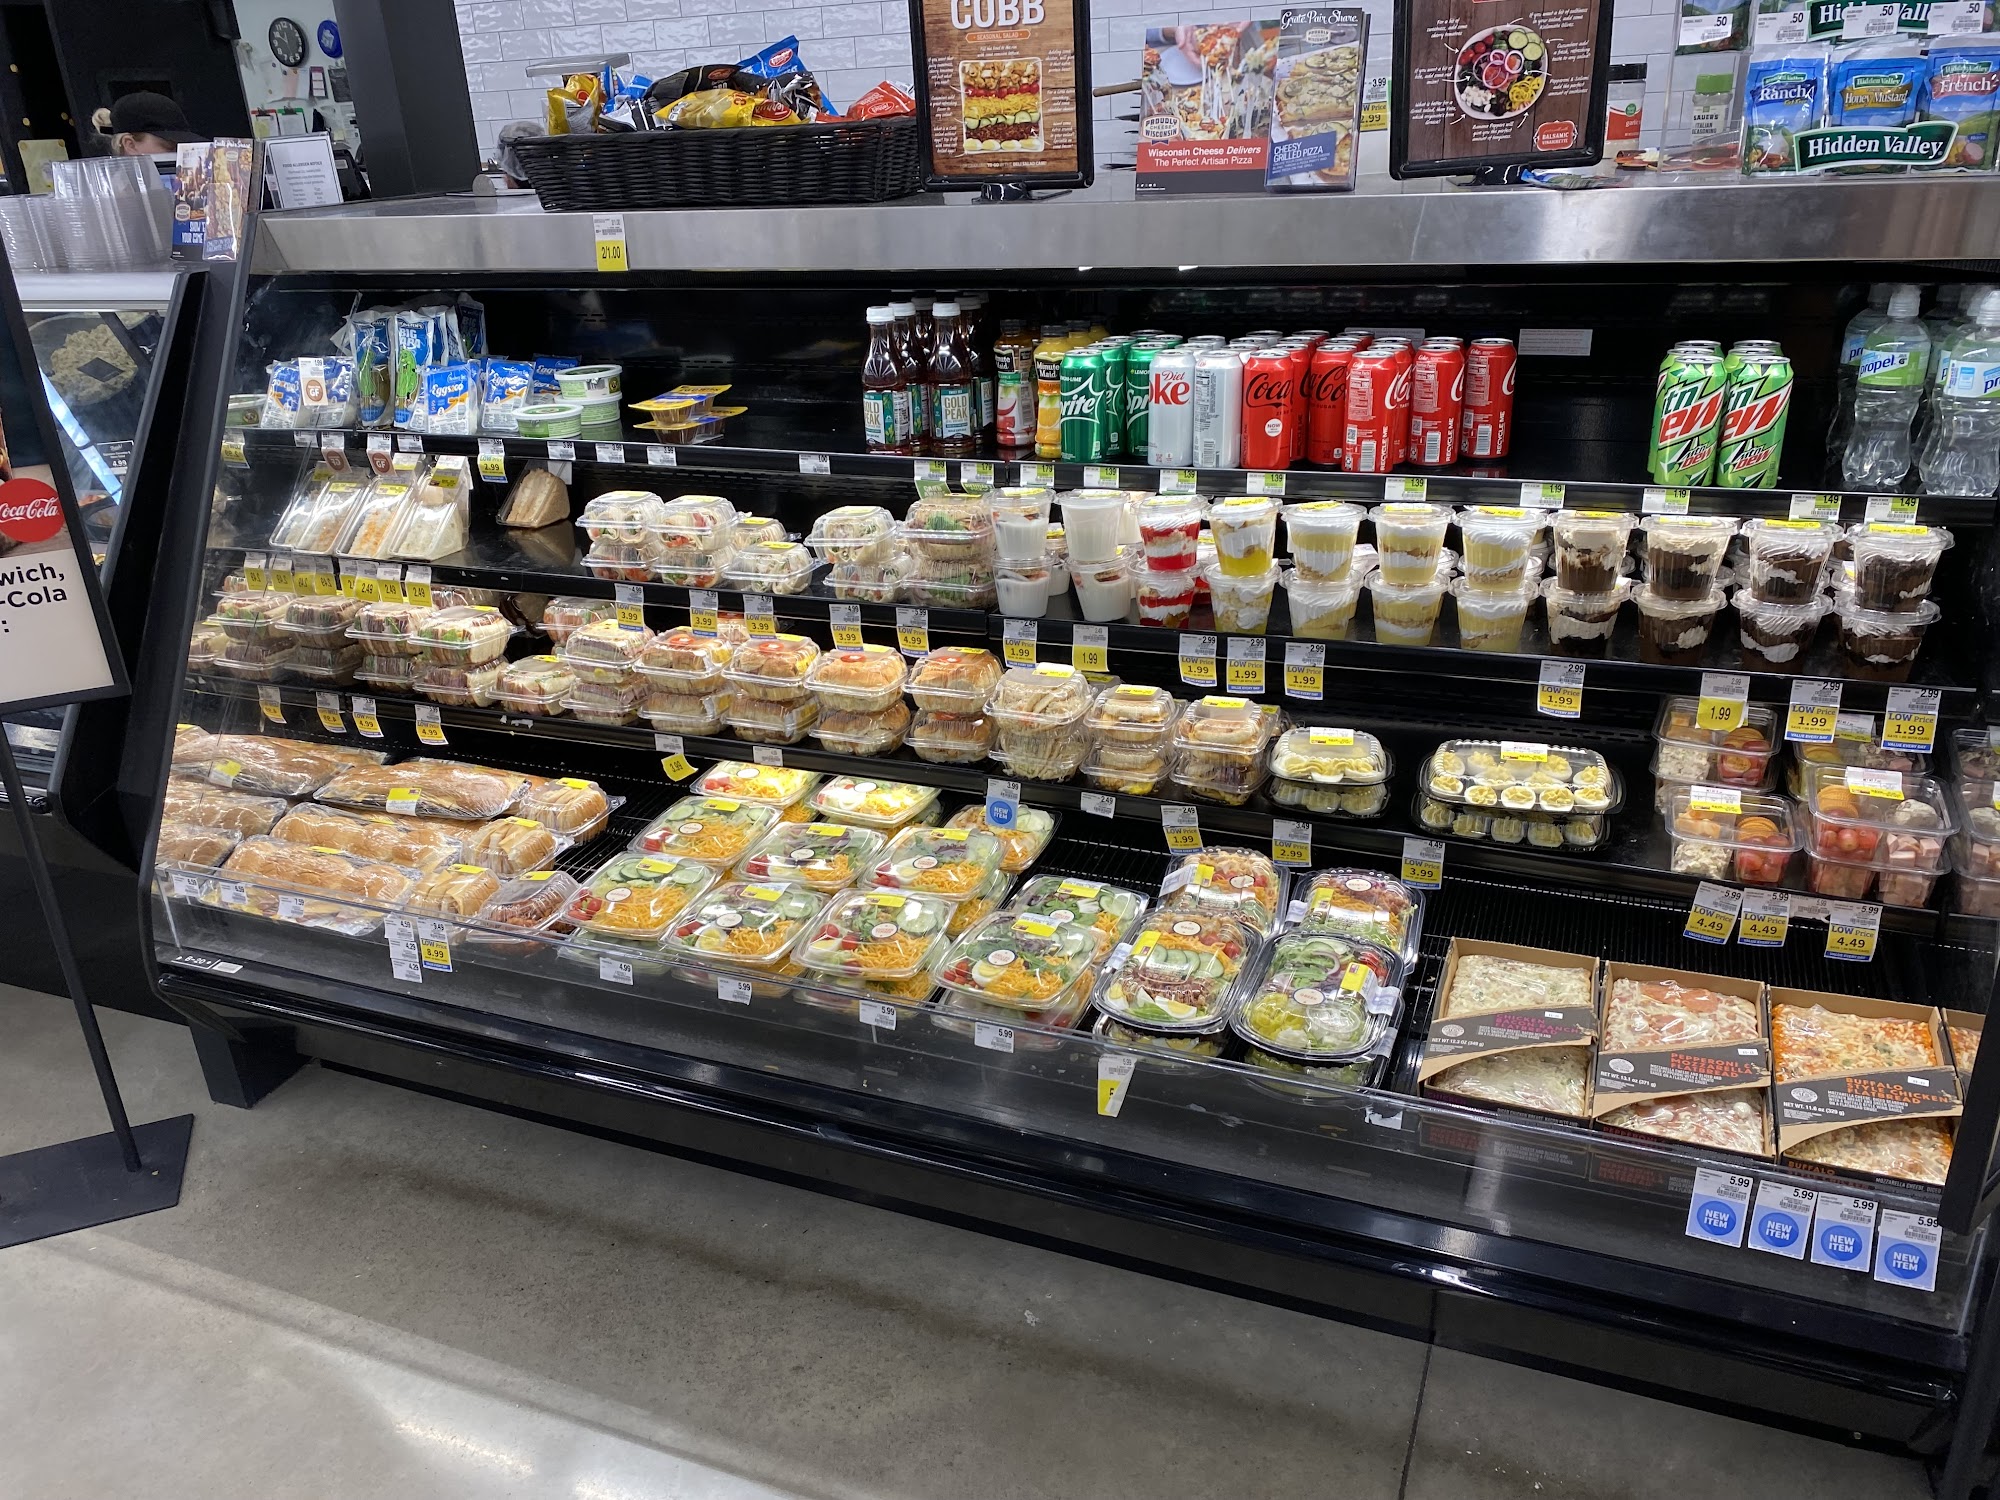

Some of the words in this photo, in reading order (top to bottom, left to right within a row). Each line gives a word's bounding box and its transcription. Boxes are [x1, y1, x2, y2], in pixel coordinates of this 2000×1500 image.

[950, 0, 1045, 30] COBB
[1789, 12, 1804, 24] .50
[1713, 16, 1728, 27] .50
[976, 32, 1002, 41] SEASONAL
[1002, 31, 1019, 39] SALAD
[1372, 77, 1387, 87] 3.99
[1856, 77, 1880, 85] Hidden
[1880, 77, 1901, 86] Valley
[1939, 77, 1991, 94] French
[1759, 85, 1806, 102] Ranch
[1845, 92, 1871, 106] Honey
[1872, 90, 1909, 103] Mustard
[1693, 113, 1719, 121] SAUER'S
[1145, 118, 1178, 127] PROUDLY
[1145, 128, 1178, 138] WISCONSIN
[1541, 131, 1570, 140] BALSAMIC
[1148, 148, 1191, 157] Wisconsin
[1193, 147, 1224, 156] Cheese
[1226, 146, 1261, 155] Delivers
[1274, 142, 1302, 155] CHEESY
[1807, 134, 1880, 158] Hidden
[1883, 134, 1944, 159] Valley
[1273, 150, 1302, 163] GRILLED
[1302, 145, 1324, 157] PIZZA
[1154, 158, 1170, 167] The
[1171, 157, 1199, 166] Perfect
[1201, 156, 1229, 165] Artisan
[1231, 156, 1253, 164] Pizza
[601, 246, 621, 259] 2/1.00
[399, 328, 417, 339] BIG
[1036, 361, 1060, 371] Minute
[1860, 355, 1895, 376] propel
[1039, 369, 1058, 379] Maid
[1161, 370, 1186, 381] Diet
[309, 387, 320, 397] GF
[944, 395, 967, 408] GOLD
[945, 408, 968, 420] PEAK
[1500, 410, 1505, 422] ME
[1449, 417, 1454, 429] ME
[1382, 426, 1389, 438] ME
[1497, 422, 1505, 455] RECYCLE
[1446, 429, 1454, 462] RECYCLE
[1380, 439, 1388, 471] RECYCLE
[112, 459, 127, 467] 4.99
[376, 460, 386, 469] GF
[483, 463, 500, 471] 2.99
[981, 461, 993, 471] 1.79
[1042, 463, 1053, 473] 1.79
[1105, 468, 1117, 476] 1.39
[1184, 470, 1195, 478] 1.39
[1271, 473, 1283, 483] 1.39
[1411, 478, 1424, 487] 1.39
[1549, 484, 1562, 493] 1.19
[1673, 489, 1687, 498] 1.19
[1823, 495, 1839, 504] 1.49
[1900, 497, 1916, 507] 1.49
[361, 584, 374, 594] 2.49
[384, 584, 397, 594] 2.49
[413, 587, 426, 597] 2.49
[631, 586, 642, 594] 4.99
[847, 604, 859, 613] 4.99
[621, 611, 638, 621] 3.99
[695, 617, 712, 626] 3.99
[751, 622, 769, 631] 3.99
[838, 633, 857, 642] 3.99
[903, 636, 922, 645] 4.99
[1202, 636, 1216, 644] 2.99
[1250, 639, 1265, 647] 2.99
[1010, 648, 1030, 657] 1.99
[1310, 644, 1324, 653] 2.99
[1082, 652, 1098, 664] 1.99
[1187, 665, 1209, 674] 1.99
[1568, 664, 1584, 673] 2.99
[1234, 670, 1257, 679] 1.99
[1293, 675, 1316, 684] 1.99
[1541, 686, 1561, 694] LOW
[1562, 689, 1580, 697] Price
[1547, 695, 1573, 705] 1.99
[1710, 707, 1731, 721] 1.99
[1791, 704, 1816, 714] LOW
[1816, 708, 1836, 716] Price
[1798, 716, 1827, 727] 1.99
[1888, 713, 1913, 722] LOW
[1913, 715, 1934, 724] Price
[359, 720, 374, 728] 4.99
[422, 728, 438, 736] 4.99
[1894, 724, 1925, 735] 1.99
[669, 760, 683, 773] 3.99
[1100, 796, 1114, 805] 2.49
[993, 806, 1009, 814] NEW
[993, 812, 1008, 820] ITEM
[1295, 822, 1310, 830] 3.49
[1173, 835, 1194, 844] 1.99
[1428, 841, 1443, 849] 4.49
[1280, 849, 1303, 858] 2.99
[1404, 859, 1423, 867] LOW
[1424, 861, 1441, 869] Price
[1409, 868, 1434, 878] 3.99
[1724, 890, 1742, 900] 5.99
[1771, 892, 1789, 901] 5.99
[1693, 905, 1714, 917] LOW
[1715, 913, 1733, 923] Price
[1744, 913, 1766, 922] LOW
[1767, 917, 1786, 925] Price
[400, 920, 411, 929] 4.59
[1696, 918, 1723, 930] 4.49
[1749, 923, 1778, 934] 4.49
[1831, 925, 1854, 935] LOW
[1855, 930, 1875, 938] Price
[405, 941, 416, 951] 4.29
[1837, 936, 1866, 948] 4.49
[426, 948, 444, 958] 8.99
[408, 962, 419, 971] 4.29
[618, 963, 631, 973] 4.99
[737, 982, 751, 991] 5.99
[881, 1006, 895, 1016] 5.99
[1496, 1014, 1545, 1024] CHICKEN
[1495, 1017, 1534, 1028] BACON
[1539, 1024, 1578, 1034] RANCH
[1495, 1022, 1558, 1035] FLATBREAD
[997, 1028, 1013, 1039] 5.99
[1671, 1052, 1739, 1068] PEPPERONI
[1670, 1057, 1753, 1075] MOZZARELLA
[1670, 1062, 1739, 1078] FLATBREAD
[1845, 1076, 1903, 1091] BUFFALO
[1847, 1083, 1885, 1094] STYLE
[1890, 1089, 1948, 1103] CHICKEN
[1847, 1088, 1921, 1104] FLATBREAD
[1788, 1161, 1836, 1175] BUFFALO
[1729, 1176, 1751, 1188] 5.99
[1792, 1188, 1815, 1201] 5.99
[1853, 1199, 1875, 1211] 5.99
[1706, 1208, 1730, 1221] NEW
[1704, 1216, 1728, 1229] ITEM
[1767, 1220, 1793, 1233] NEW
[1917, 1216, 1939, 1229] 5.99
[1765, 1227, 1790, 1241] ITEM
[1829, 1234, 1855, 1247] NEW
[1828, 1241, 1854, 1254] ITEM
[1893, 1251, 1920, 1264] NEW
[1892, 1259, 1918, 1272] ITEM
